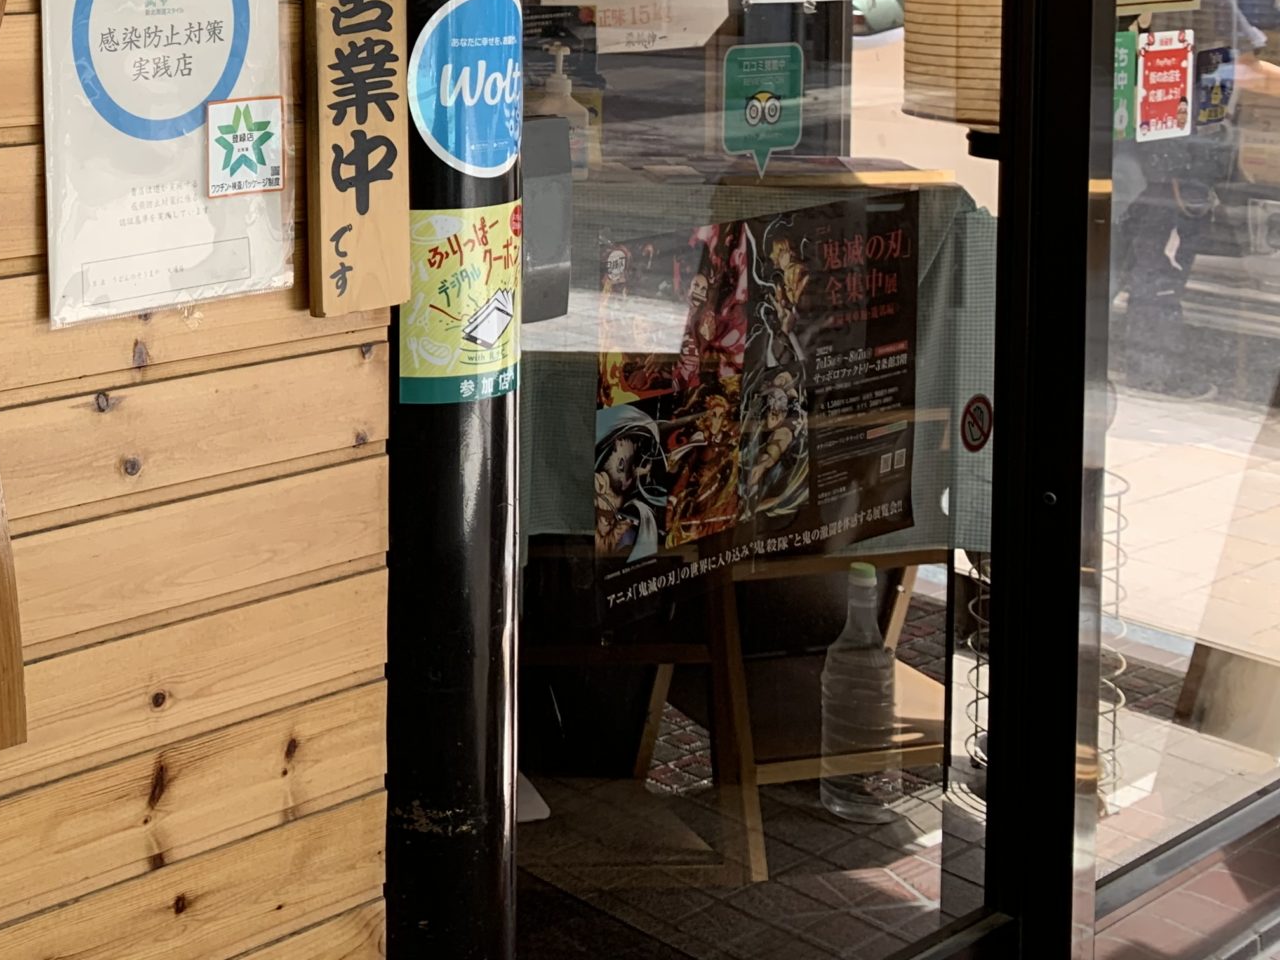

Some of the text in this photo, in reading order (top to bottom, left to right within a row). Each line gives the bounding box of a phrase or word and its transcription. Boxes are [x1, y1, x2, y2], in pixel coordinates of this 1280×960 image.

[98, 20, 225, 54] 感染防止対策
[131, 53, 193, 82] 実践店
[439, 58, 521, 107] Wolt
[437, 263, 482, 308] デジタル
